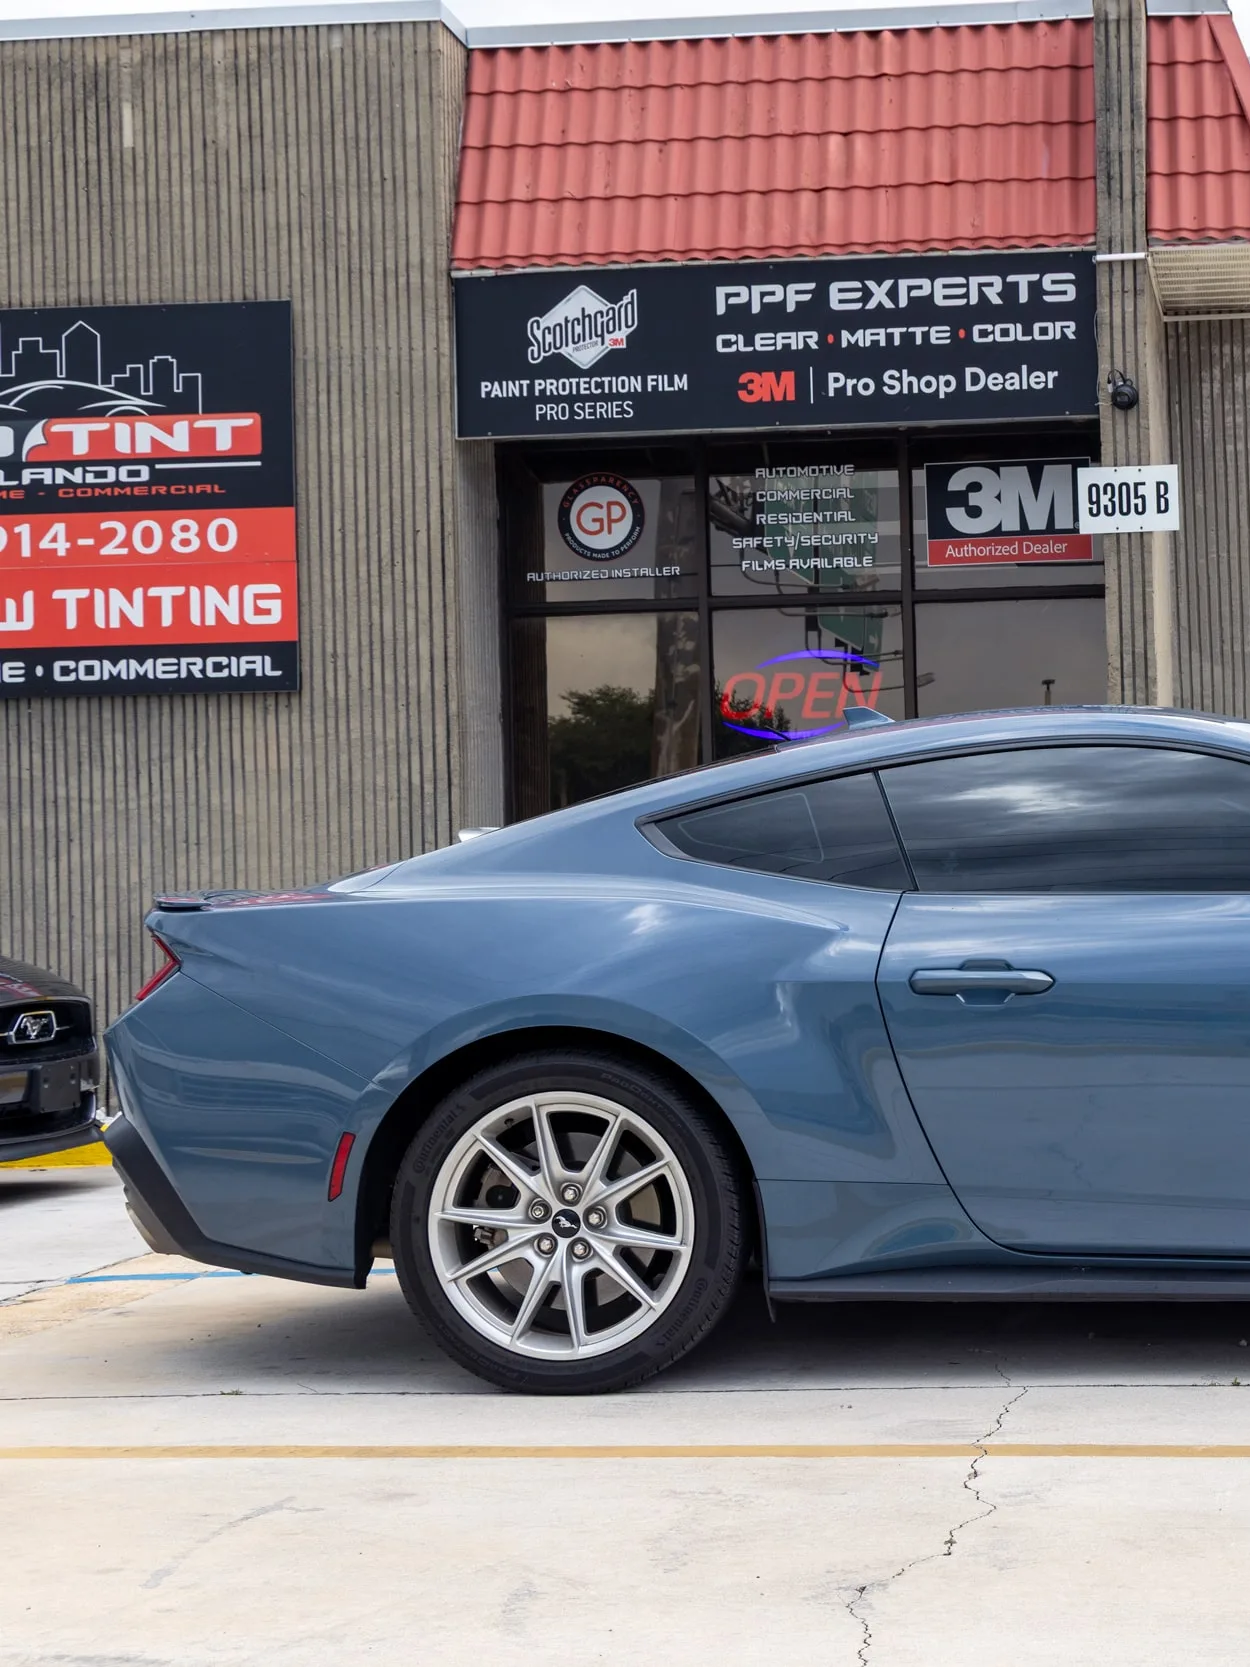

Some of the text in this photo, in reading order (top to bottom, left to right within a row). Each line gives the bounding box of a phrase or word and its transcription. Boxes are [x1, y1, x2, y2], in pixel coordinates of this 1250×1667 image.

[715, 272, 1076, 315] PPF EXPERTS
[528, 289, 637, 363] Scotchgard
[716, 321, 1076, 353] CLEAR MATTE COLOR
[608, 337, 624, 347] 3M
[480, 374, 688, 398] PAINT PROTECTION FILM
[737, 371, 796, 403] 3M
[827, 365, 1058, 399] Pro Shop Dealer
[535, 401, 634, 421] PRO SERIES
[50, 418, 254, 455] TINT
[755, 464, 855, 479] AUTOMOTIVE
[58, 484, 225, 498] COMMERCIAL
[756, 487, 855, 502] COMMERCIAL
[945, 464, 1074, 534] 3M
[1088, 481, 1170, 517] 9305 B
[576, 501, 627, 536] GP
[756, 510, 856, 525] RESIDENTIAL
[564, 532, 591, 557] PRODUCTS
[620, 526, 641, 552] PERFORM
[732, 532, 879, 550] SAFETY/SECURITY
[945, 541, 1068, 558] Authorized Dealer
[526, 566, 681, 583] AUTHORIZED INSTALLER
[742, 555, 873, 572] FILMS AVAILABLE
[52, 584, 282, 630] TINTING
[53, 655, 282, 682] COMMERCIAL
[720, 672, 882, 719] OPEN
